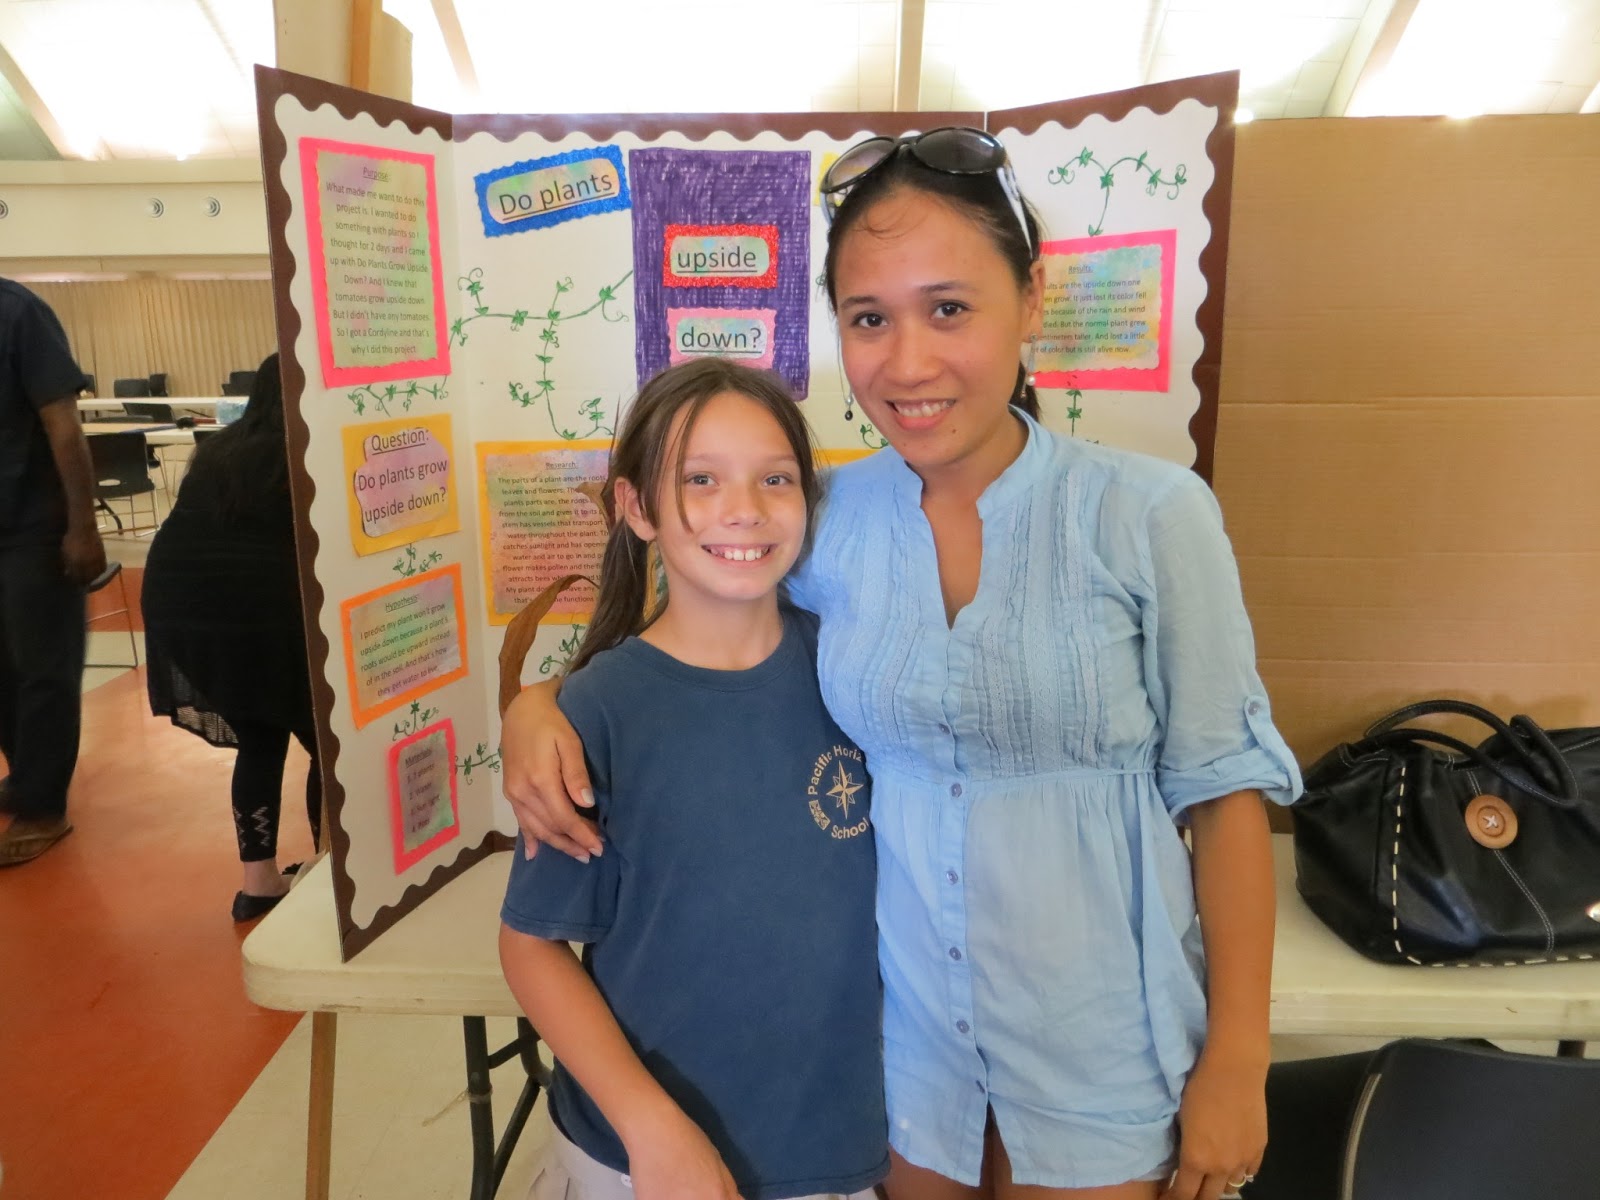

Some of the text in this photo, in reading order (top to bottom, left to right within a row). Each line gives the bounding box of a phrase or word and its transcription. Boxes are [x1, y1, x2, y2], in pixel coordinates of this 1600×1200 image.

[326, 182, 344, 194] What
[346, 187, 366, 197] made
[378, 193, 395, 202] want
[414, 197, 425, 206] this
[499, 172, 614, 216] Do plants
[336, 204, 416, 222] project wanted do
[336, 222, 407, 238] something with plants
[331, 238, 358, 250] thought
[360, 240, 369, 250] for
[376, 244, 390, 254] days
[392, 246, 404, 254] and
[341, 257, 356, 266] with
[358, 258, 366, 268] Do
[368, 259, 388, 270] Plants
[388, 261, 406, 270] Grow
[408, 263, 428, 272] Upside
[677, 246, 757, 274] upside
[344, 274, 418, 288] Down? And knew that
[1084, 280, 1106, 288] upside
[336, 293, 406, 304] tomatoes grow upside
[333, 310, 344, 319] But
[370, 311, 386, 320] have
[388, 312, 400, 322] any
[1110, 320, 1128, 328] plant
[350, 329, 362, 338] got
[400, 328, 411, 338] and
[682, 326, 763, 350] down?
[351, 346, 366, 356] why
[370, 345, 380, 354] did
[382, 345, 393, 354] this
[371, 429, 430, 452] Question:
[358, 460, 448, 491] Do plants grow
[364, 486, 446, 524] upside down?
[530, 542, 555, 550] sunlight
[364, 625, 386, 640] predict
[398, 615, 412, 626] plant
[431, 604, 446, 615] grow
[360, 642, 381, 656] upside
[382, 635, 399, 648] down
[400, 627, 423, 640] because
[360, 630, 450, 672] roots would upward instead
[381, 670, 391, 680] the
[406, 659, 417, 668] And
[435, 648, 447, 656] how
[378, 673, 420, 697] they get water
[808, 752, 832, 796] Pacific
[832, 817, 870, 840] School
